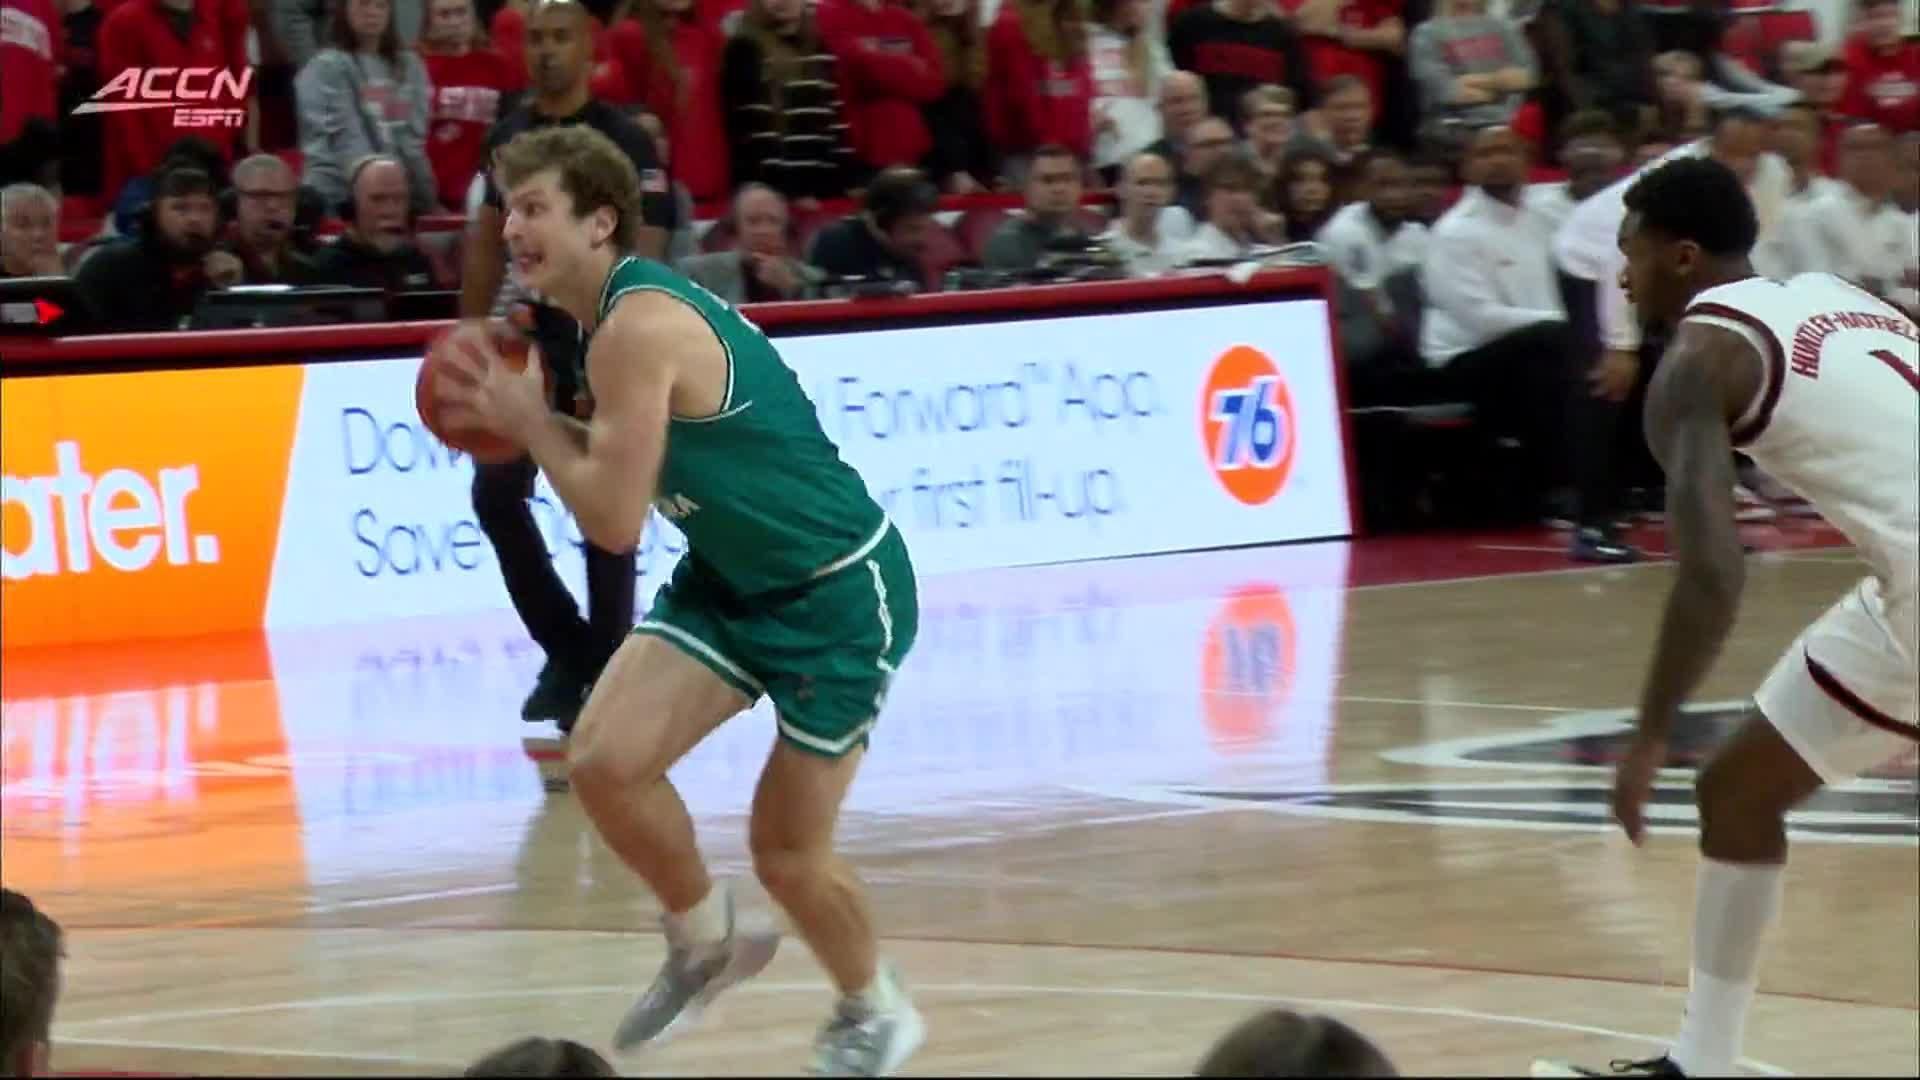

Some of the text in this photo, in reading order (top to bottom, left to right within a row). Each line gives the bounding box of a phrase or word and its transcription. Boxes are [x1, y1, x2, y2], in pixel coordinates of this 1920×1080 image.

[1212, 376, 1289, 471] 76
[352, 507, 483, 578] Save
[911, 462, 987, 530] first
